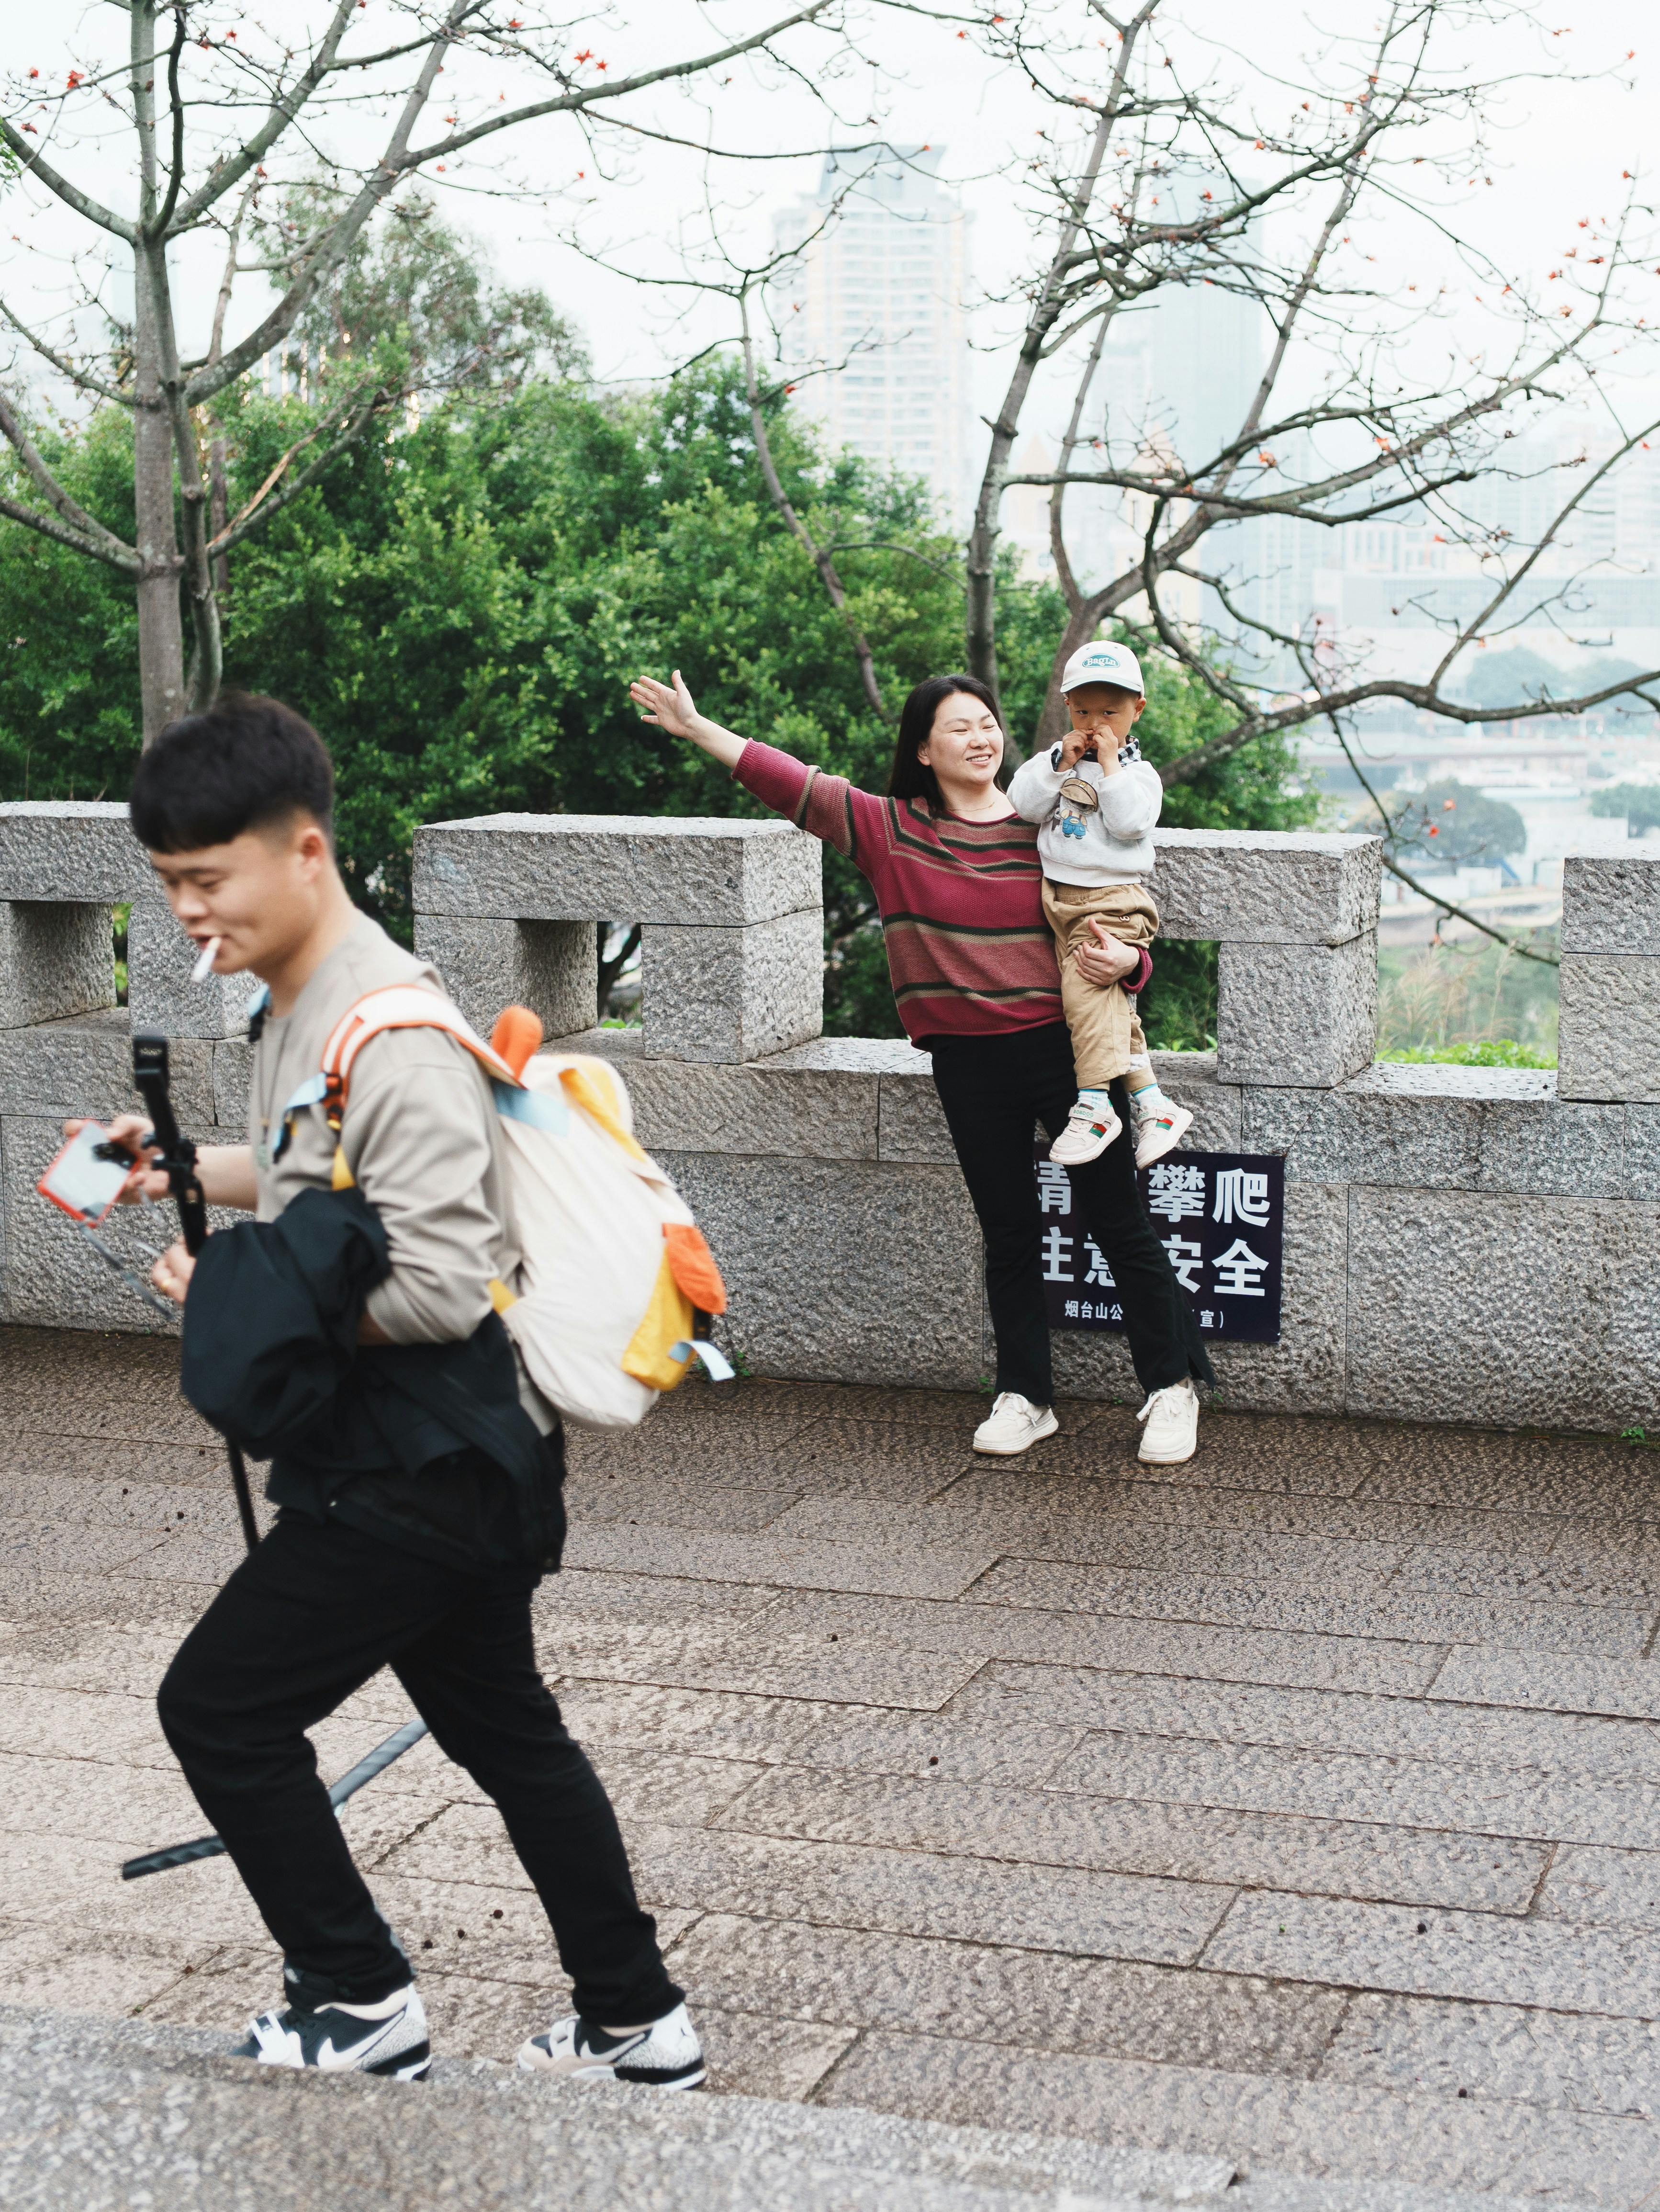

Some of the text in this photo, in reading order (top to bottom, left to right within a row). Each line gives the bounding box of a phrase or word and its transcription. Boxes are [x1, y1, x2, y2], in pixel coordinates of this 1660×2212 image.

[1073, 1109, 1094, 1117] BOBDOG
[1034, 1161, 1270, 1227] 请攀爬
